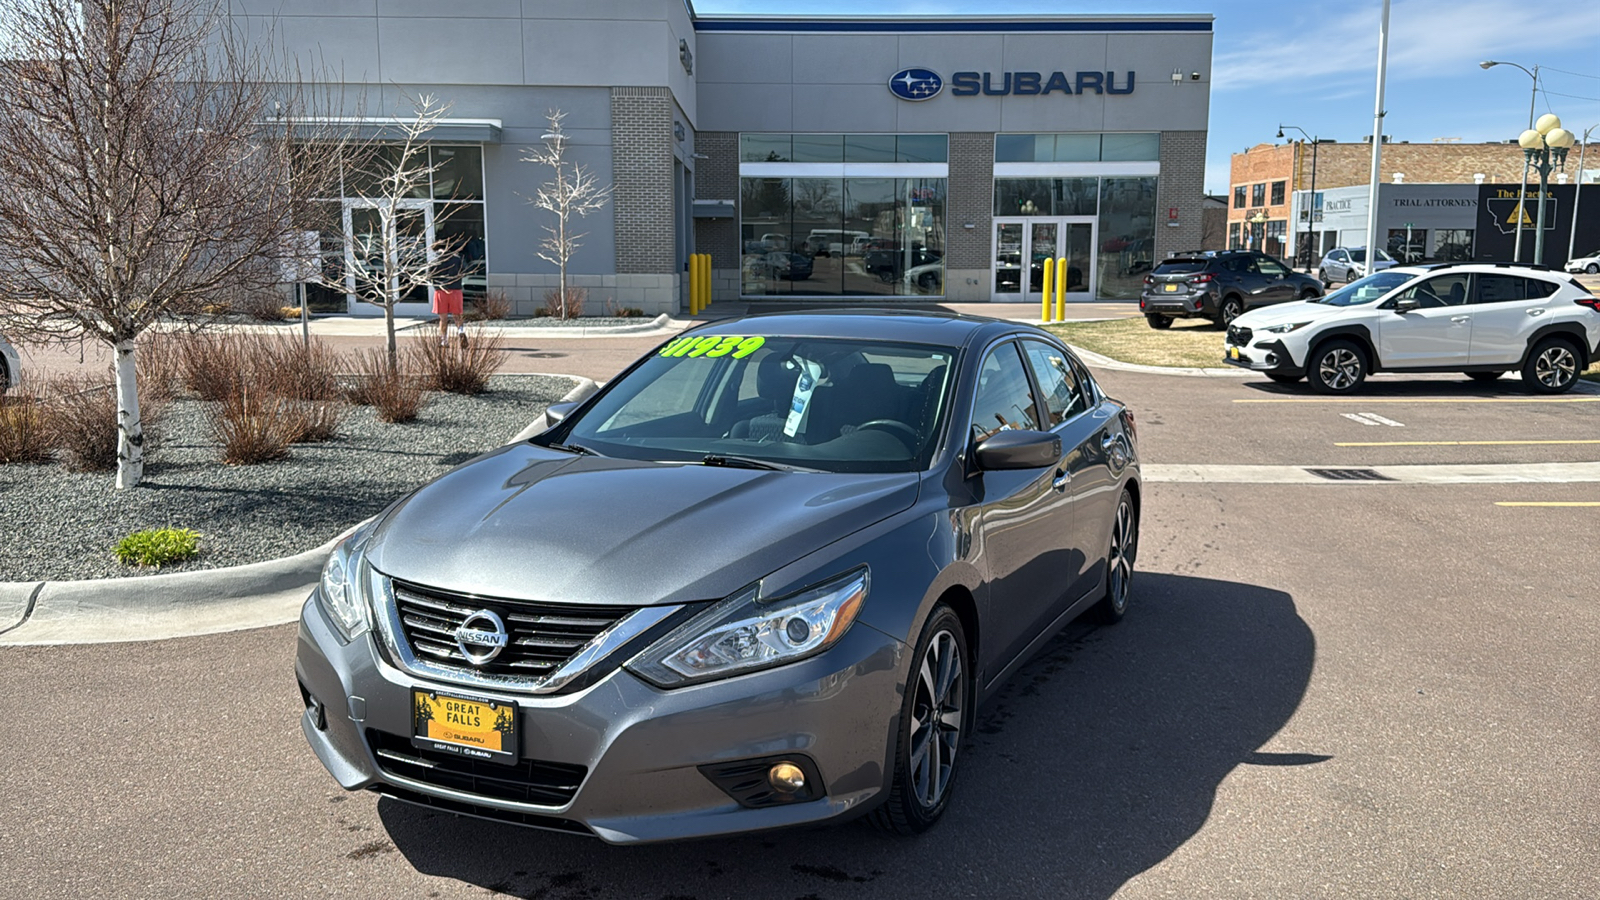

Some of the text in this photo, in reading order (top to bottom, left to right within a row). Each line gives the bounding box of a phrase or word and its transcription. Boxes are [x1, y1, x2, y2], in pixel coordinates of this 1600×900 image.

[951, 71, 1136, 96] SUBARU
[1497, 189, 1553, 198] The Pacte
[1326, 199, 1352, 211] PRACTICE
[1393, 199, 1478, 207] TRIAL ATTORNEYS
[458, 630, 500, 645] NISSAN
[446, 701, 480, 715] GREAT
[447, 712, 481, 727] FALLS
[453, 734, 485, 744] SUBARU
[446, 745, 459, 753] FALLS
[470, 750, 492, 758] SUBARU
